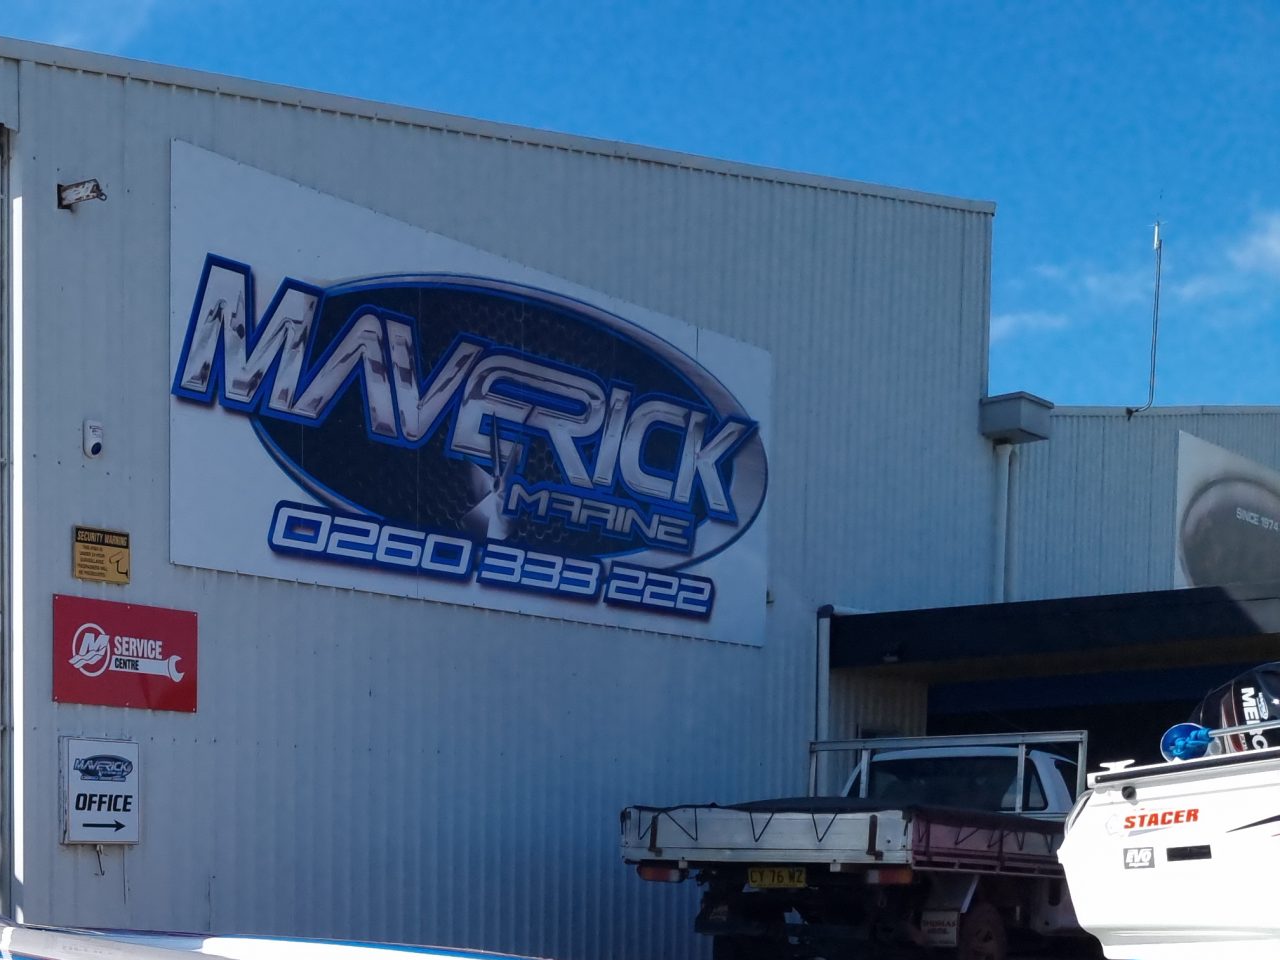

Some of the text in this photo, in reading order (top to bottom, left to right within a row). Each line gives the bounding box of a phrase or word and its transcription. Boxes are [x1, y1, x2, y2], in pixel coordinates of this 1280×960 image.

[174, 254, 758, 521] MAVERICK
[505, 482, 696, 549] MARINE
[1236, 507, 1260, 526] SINCE
[78, 530, 128, 546] SECURITY WARNING
[271, 506, 713, 613] 0260 333 222
[114, 635, 163, 659] SERVICE
[114, 658, 139, 671] CENTRE
[75, 793, 133, 812] OFFICE
[1123, 808, 1200, 829] STACER
